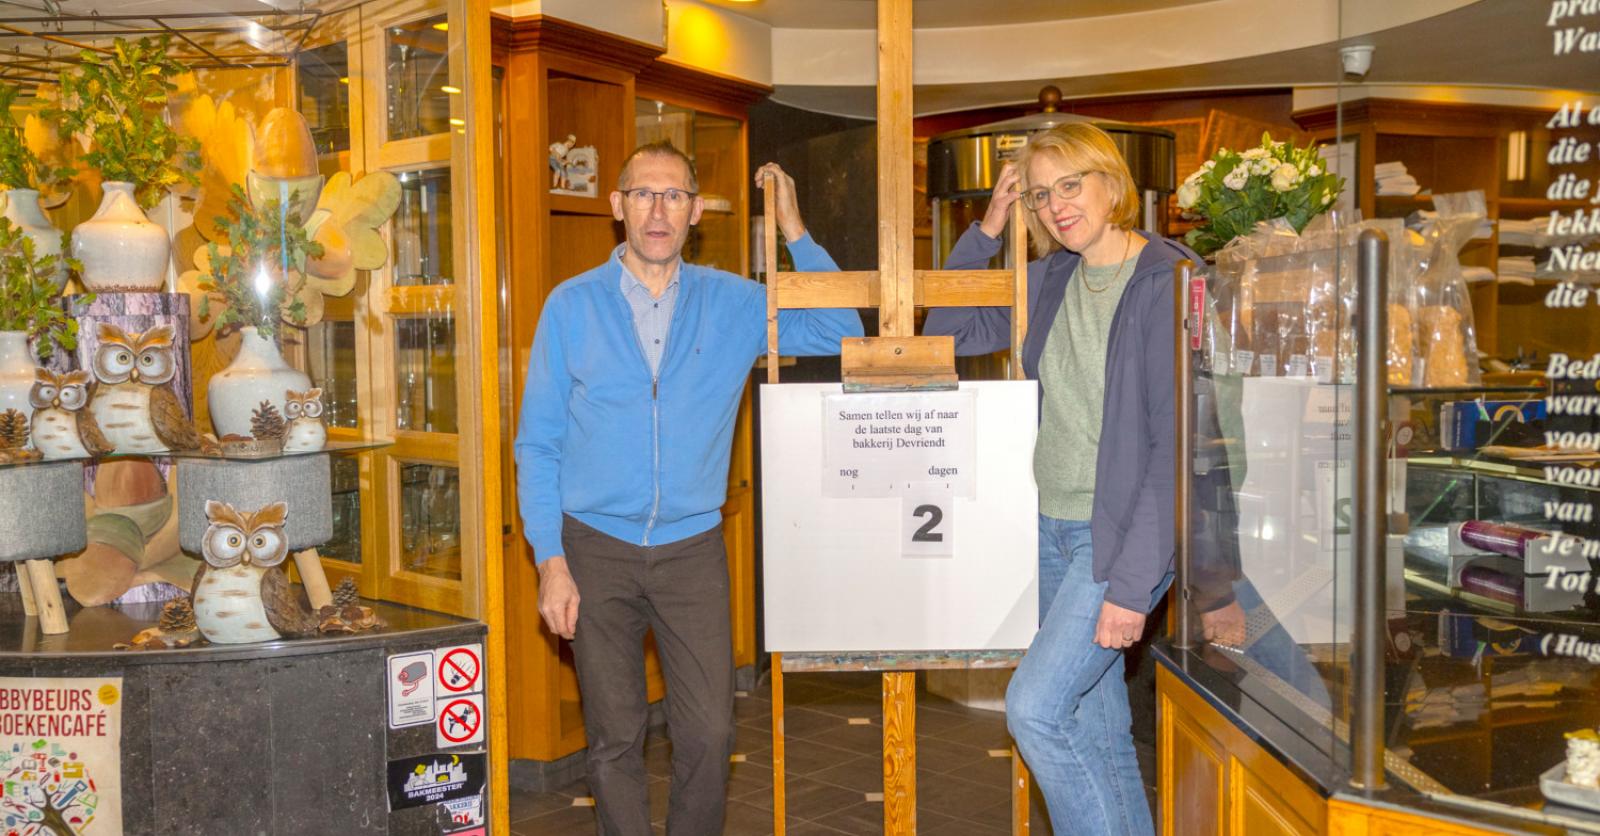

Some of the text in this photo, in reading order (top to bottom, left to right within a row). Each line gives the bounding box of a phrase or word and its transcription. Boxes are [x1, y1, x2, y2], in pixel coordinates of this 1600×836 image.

[1546, 0, 1600, 26] pra
[1553, 27, 1600, 56] Wa
[1546, 101, 1582, 128] Al
[1547, 136, 1591, 165] die
[1546, 173, 1590, 200] die
[1544, 281, 1588, 307] die
[1545, 352, 1600, 379] Bed
[839, 409, 959, 421] Samen tellen wij af naar
[855, 423, 943, 436] de laatste dag van
[852, 437, 945, 450] bakkerij Devriendt
[839, 467, 859, 478] nog
[928, 465, 958, 478] dagen
[912, 504, 943, 542] 2
[1544, 501, 1593, 522] van
[1541, 530, 1574, 555] Je
[1544, 565, 1591, 593] Tot
[0, 688, 92, 711] BBYBEURS
[0, 709, 107, 737] OEKENCAFÉ
[408, 783, 463, 798] BAKMEESTER
[426, 792, 444, 802] 2024
